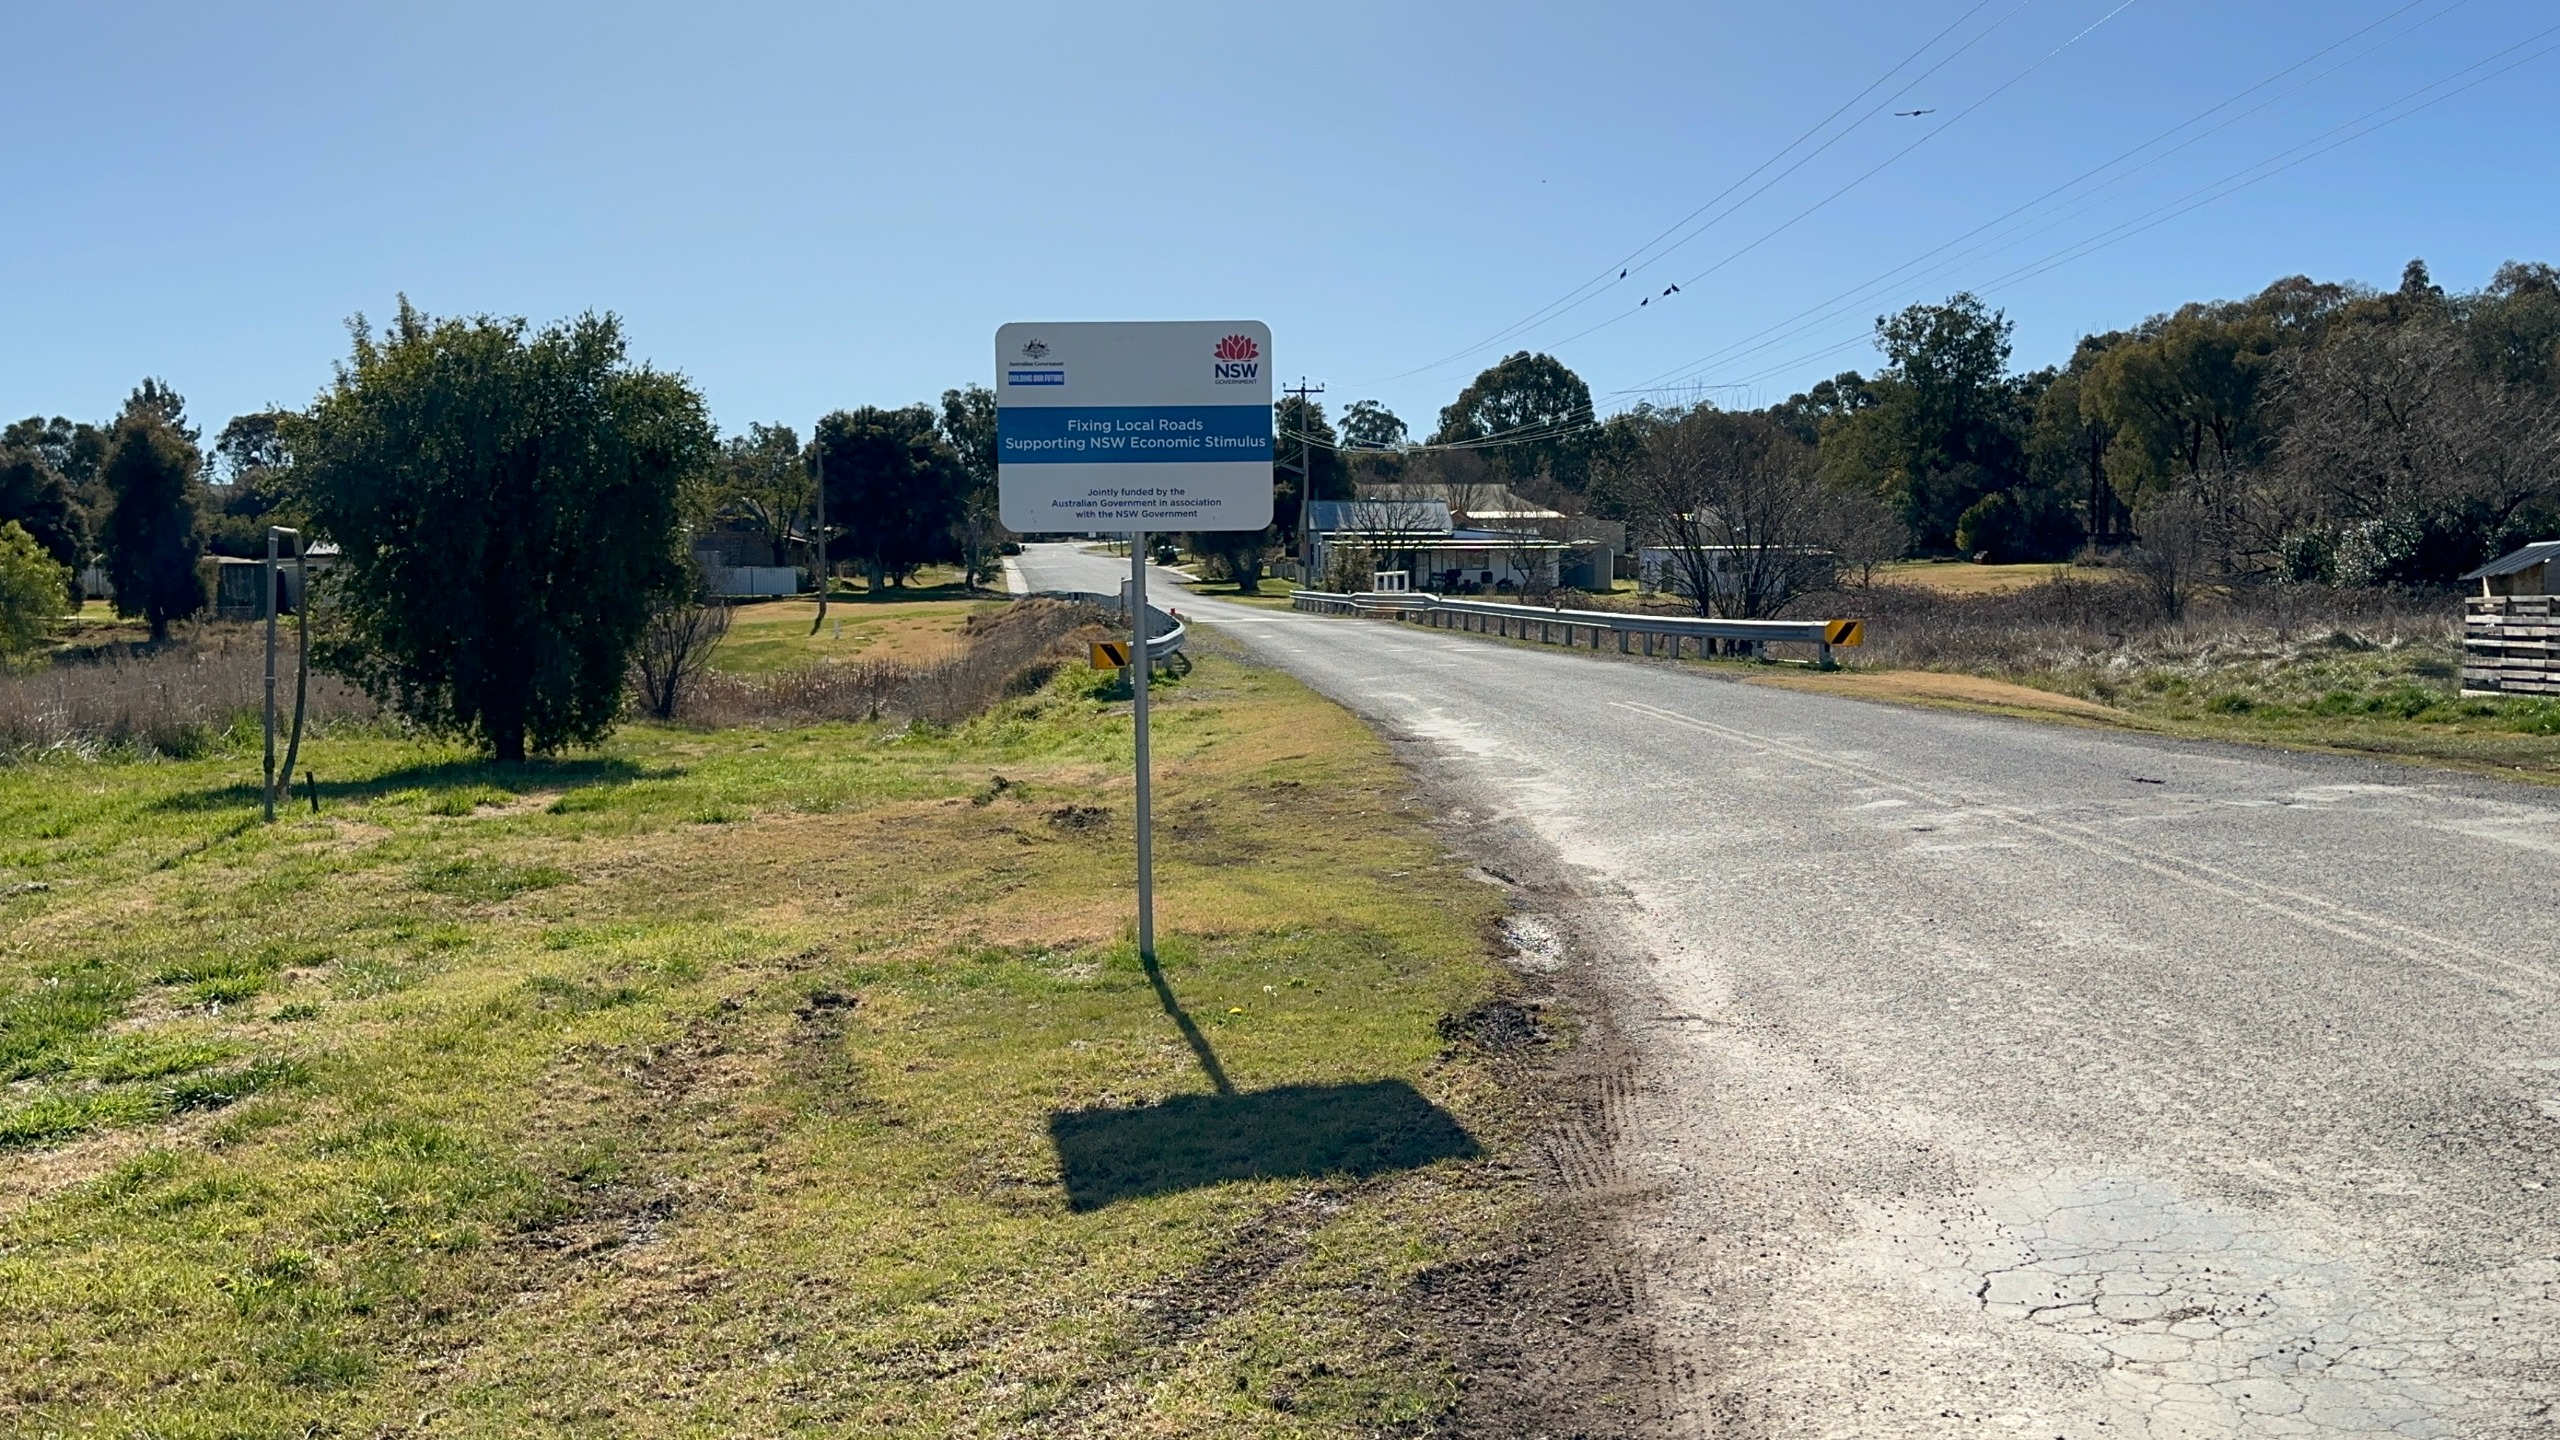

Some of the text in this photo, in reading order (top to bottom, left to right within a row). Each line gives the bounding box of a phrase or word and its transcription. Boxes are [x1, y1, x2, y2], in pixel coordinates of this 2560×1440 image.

[1215, 364, 1258, 378] NSW
[1068, 419, 1203, 433] Fixing Local Roads
[1006, 436, 1266, 451] Supporting NSW Economic Stimulus
[1088, 488, 1118, 497] Jointly
[1156, 488, 1167, 497] by
[1052, 499, 1221, 507] Australian Government in association
[1116, 510, 1139, 518] NSW
[1142, 510, 1197, 518] Government
